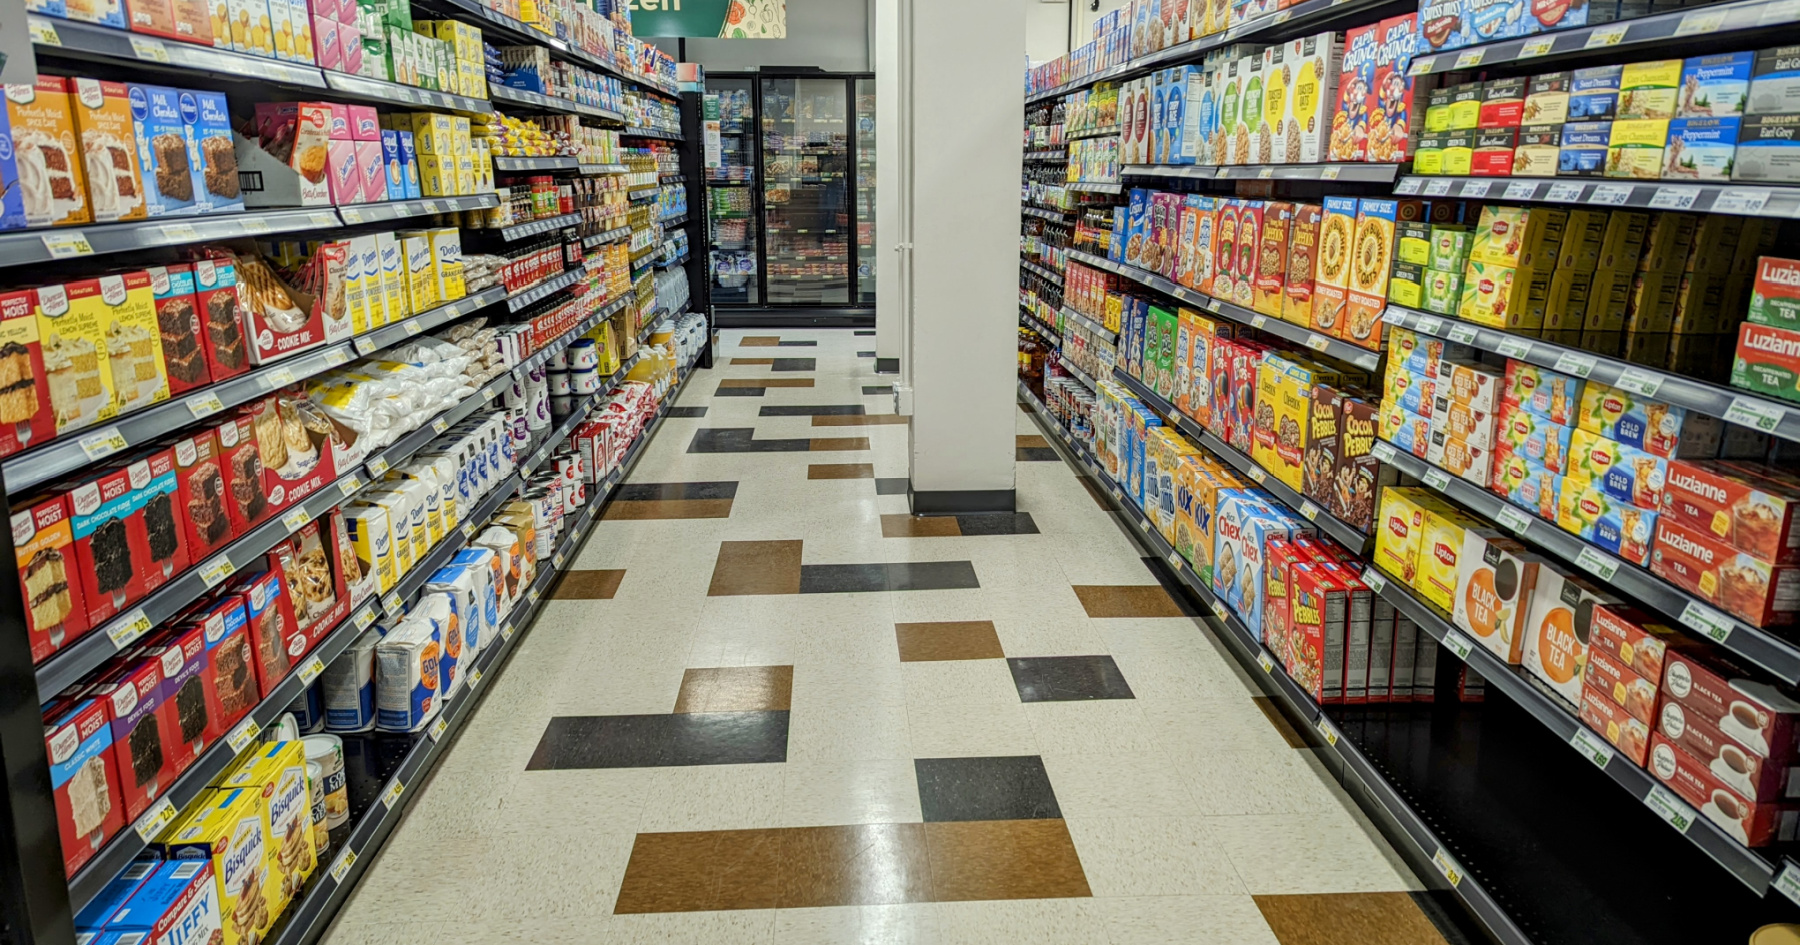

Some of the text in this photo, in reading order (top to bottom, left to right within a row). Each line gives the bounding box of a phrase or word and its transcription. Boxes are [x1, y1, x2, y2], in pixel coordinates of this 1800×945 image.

[1377, 33, 1416, 68] CRUNCH
[1697, 67, 1735, 80] Peppermint
[152, 92, 166, 105] Milk
[201, 98, 216, 111] Milk
[152, 105, 178, 119] Chocolate
[202, 109, 227, 124] Chocolate
[1682, 130, 1721, 142] Peppermint
[1760, 127, 1794, 142] Earl Grey
[1326, 199, 1354, 212] FAMILY SIZE
[1362, 201, 1393, 215] FAMILY SIZE
[1326, 262, 1340, 278] OATS
[1361, 268, 1378, 285] OATS
[1762, 262, 1800, 286] Luzia
[3, 304, 29, 318] MOIST
[1348, 294, 1381, 310] HONEY ROASTED
[1779, 307, 1796, 321] TEA
[277, 331, 311, 351] COOKIE MIX
[1744, 328, 1800, 357] Luziann
[1761, 373, 1780, 388] TEA
[1283, 391, 1302, 413] Cheerios
[1313, 400, 1335, 420] COCOA
[1603, 399, 1622, 413] Lipton
[1312, 419, 1338, 441] PEBBLES
[1346, 415, 1374, 437] COCOA
[1619, 429, 1639, 440] BREW
[1620, 420, 1640, 433] COLD
[151, 456, 168, 468] PERFECTLY
[153, 461, 170, 477] MOIST
[1591, 453, 1611, 466] Lipton
[102, 478, 125, 492] PERFECTLY
[1609, 472, 1628, 486] COLD
[1609, 479, 1628, 492] BREW
[1667, 467, 1727, 504] Luzianne
[103, 483, 126, 502] MOIST
[132, 493, 144, 503] DARK
[144, 481, 164, 497] CHOCOLATE
[288, 478, 323, 504] COOKIE MIX
[1177, 483, 1193, 517] KIX
[36, 503, 60, 518] PERFECTLY
[76, 500, 131, 530] DARK CHOCOLATE FUDGE
[1226, 510, 1236, 523] Rice
[1580, 501, 1600, 515] Lipton
[1684, 503, 1699, 518] TEA
[38, 510, 62, 529] MOIST
[1194, 501, 1211, 537] KIX
[1218, 515, 1241, 542] Chex
[1390, 518, 1408, 537] Lipton
[17, 532, 61, 558] BUTTER GOLDEN
[1241, 535, 1259, 565] Chex
[1658, 526, 1714, 565] Luzianne
[1435, 546, 1456, 565] Lipton
[1673, 562, 1687, 577] TEA
[1472, 582, 1496, 607] BLACK
[312, 605, 347, 638] COOKIE MIX
[1292, 598, 1321, 626] PEBBLES
[1474, 604, 1488, 627] TEA
[1595, 612, 1628, 641] Luzianne
[185, 641, 202, 657] MOIST
[1546, 622, 1575, 657] BLACK
[1603, 636, 1615, 649] TEA
[188, 661, 200, 673] FOOD
[1549, 647, 1565, 671] TEA
[1590, 652, 1622, 681] Luzianne
[137, 670, 157, 688] PERFECTLY
[139, 676, 158, 697] MOIST
[1597, 675, 1609, 689] TEA
[1584, 688, 1614, 718] Luzianne
[1693, 682, 1723, 705] BLACK TEA
[142, 698, 155, 711] FOOD
[80, 709, 102, 729] PERFECTLY
[81, 715, 104, 739] MOIST
[1591, 714, 1603, 727] TEA
[1703, 734, 1714, 747] TEA
[64, 737, 101, 772] CLASSIC WHITE
[1677, 766, 1706, 791] BLACK TEA
[271, 776, 305, 828] Bisquick
[224, 829, 262, 886] Bisquick
[157, 899, 187, 932] Compare
[193, 868, 211, 892] Save!
[168, 892, 210, 945] JIFFY
